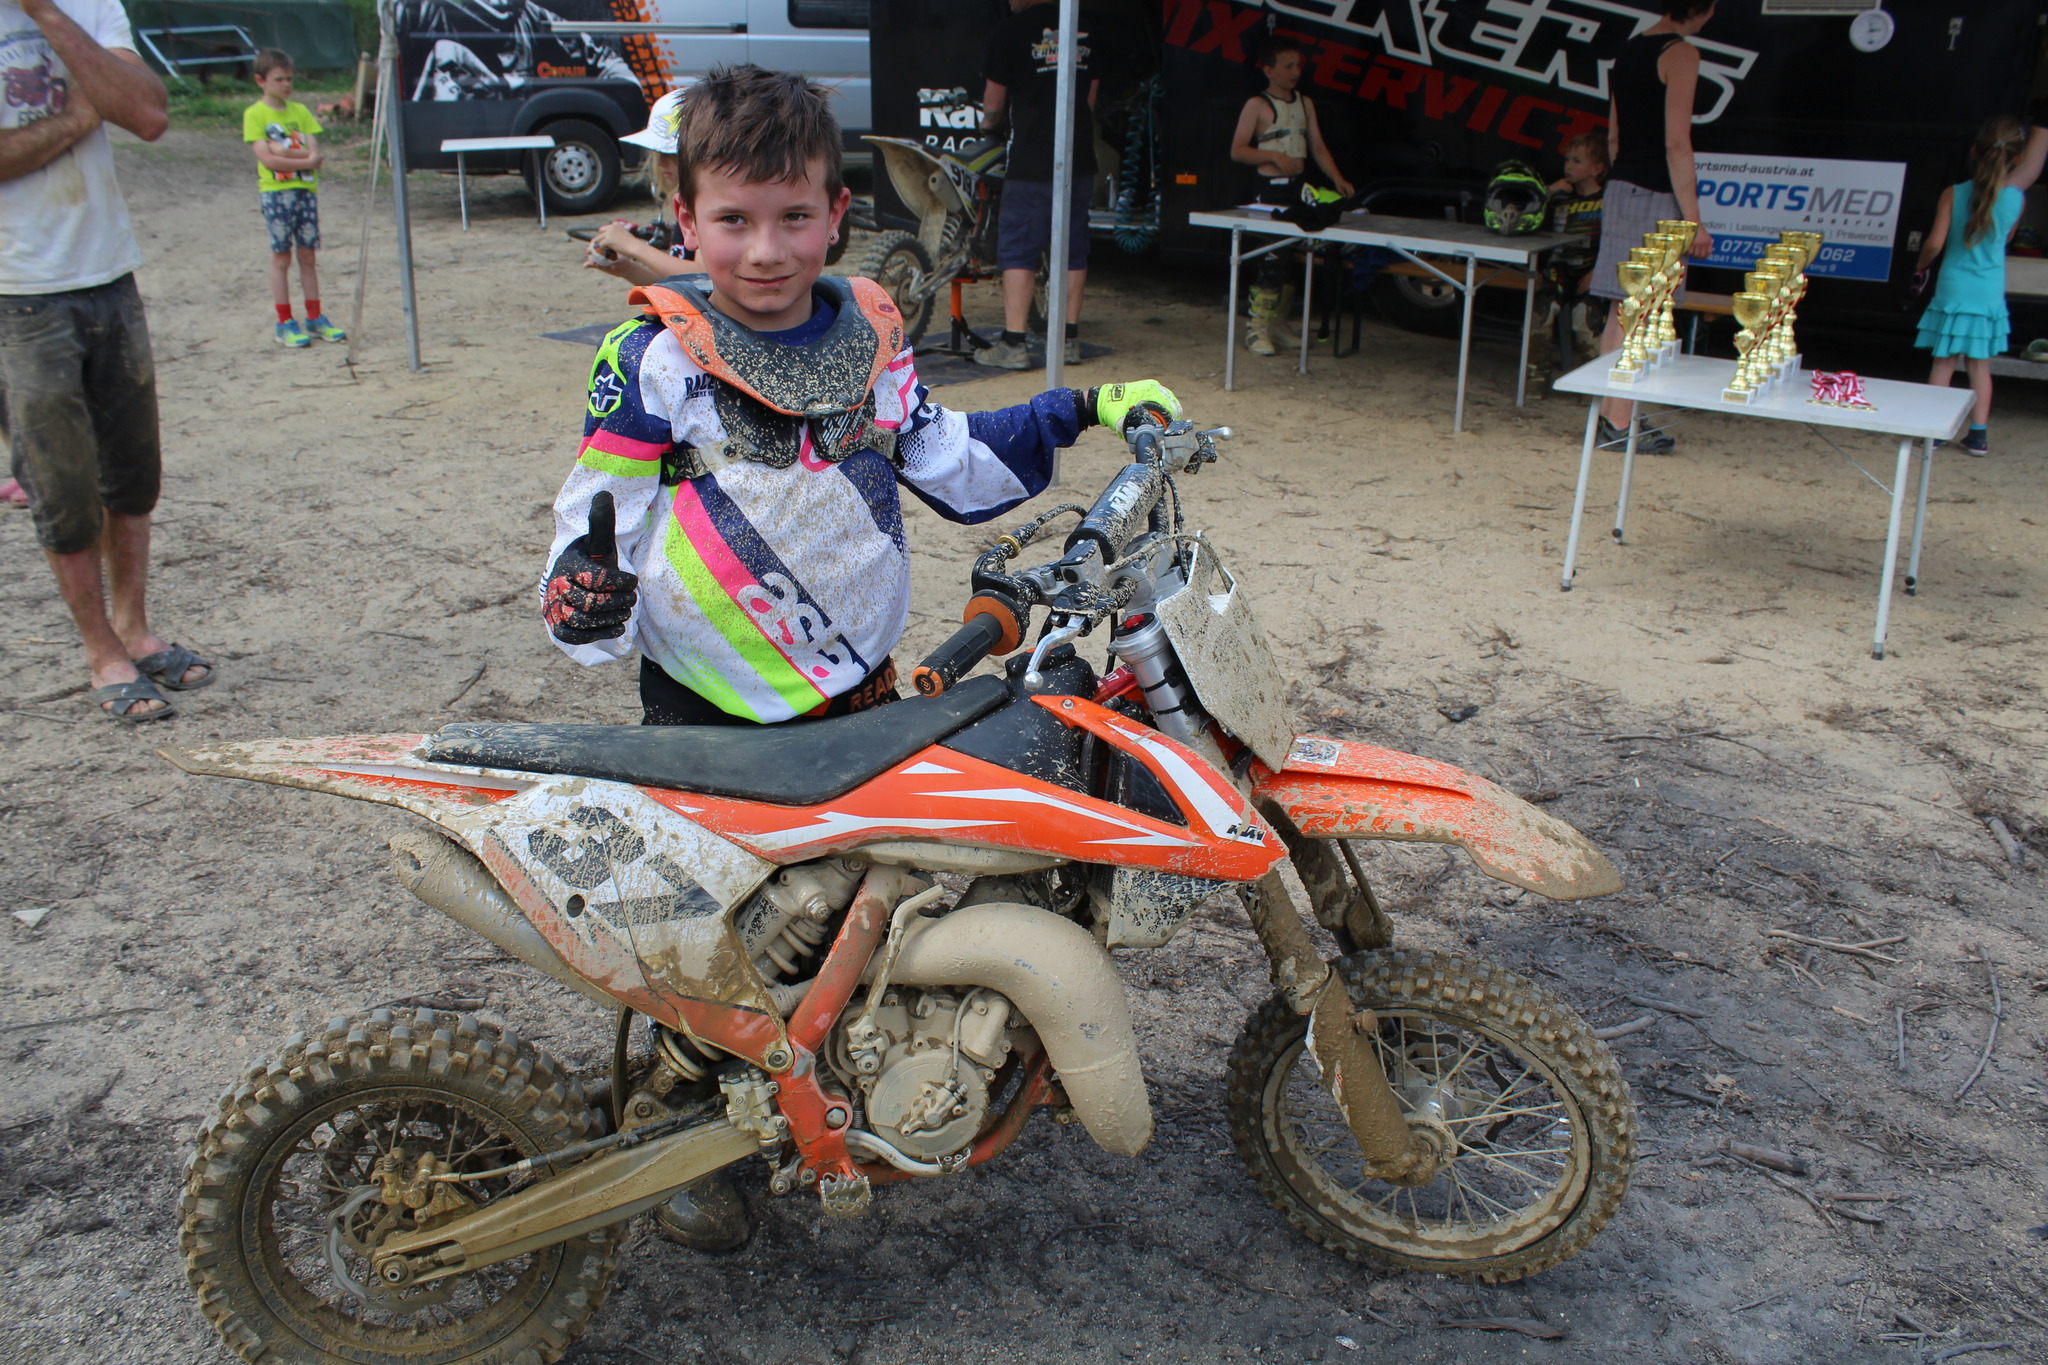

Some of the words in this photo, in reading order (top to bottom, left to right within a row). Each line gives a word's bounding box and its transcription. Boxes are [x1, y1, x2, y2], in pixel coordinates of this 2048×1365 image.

[1803, 214, 1886, 228] Austria
[1836, 228, 1889, 242] Prävention
[1721, 239, 1767, 256] 0775
[1820, 247, 1856, 262] 062
[1110, 480, 1140, 519] KTM
